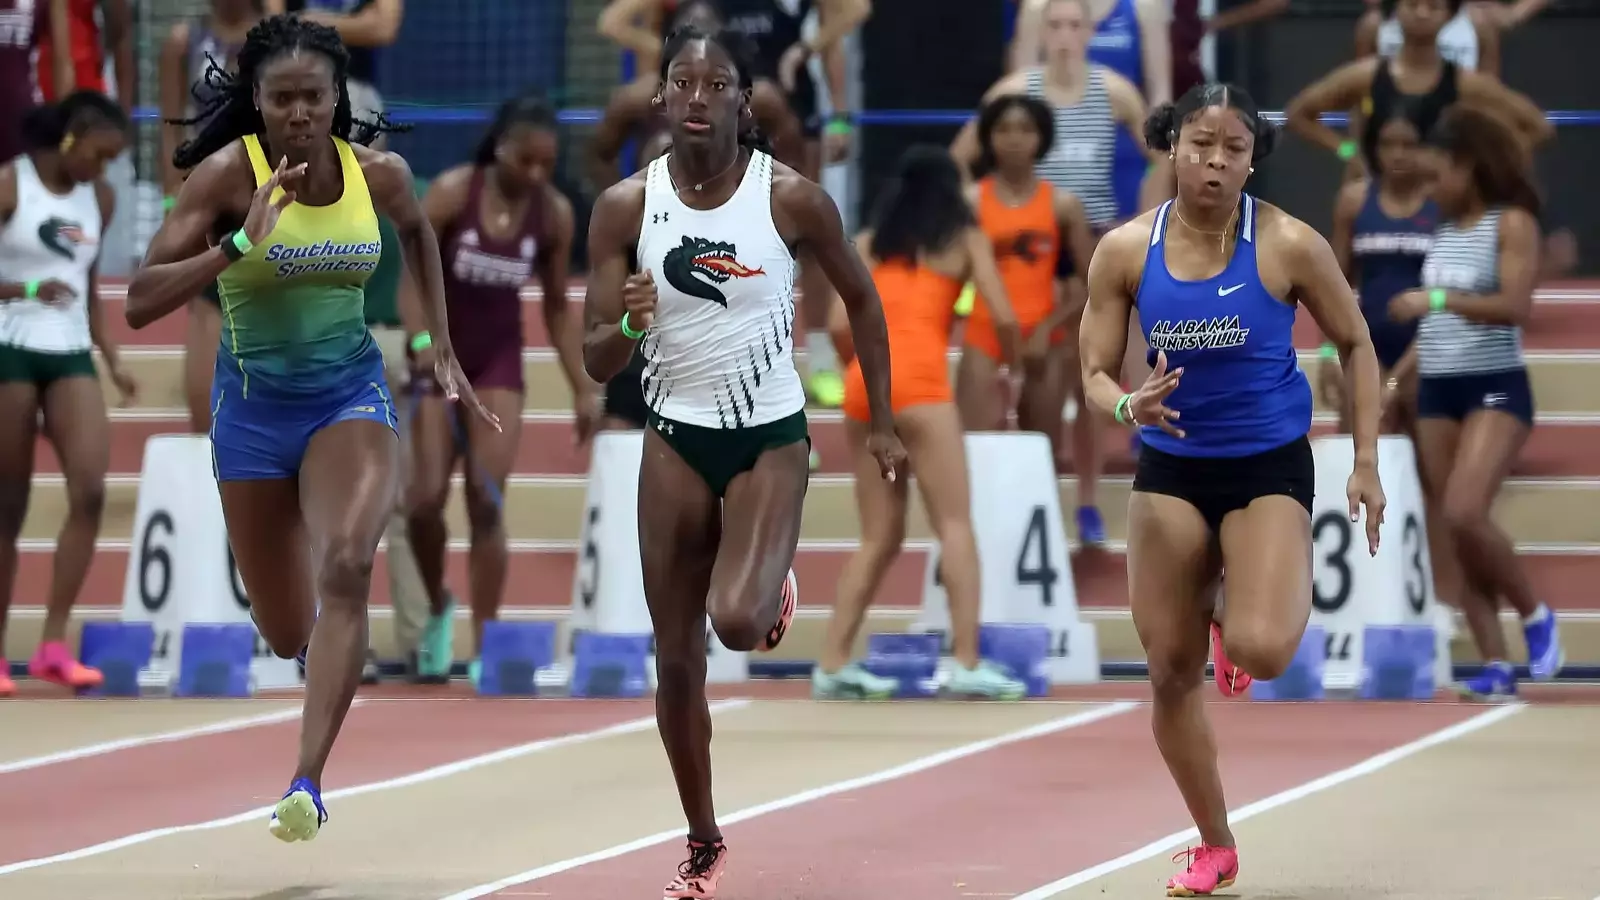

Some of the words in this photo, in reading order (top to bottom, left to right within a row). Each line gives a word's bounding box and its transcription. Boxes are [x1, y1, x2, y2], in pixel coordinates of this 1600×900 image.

[264, 238, 381, 261] Southwest
[275, 257, 376, 279] Sprinters
[1149, 329, 1250, 351] HUNTSVILLE
[1151, 315, 1240, 335] ALABAMA
[139, 509, 174, 613] 6
[580, 507, 600, 607] 5
[1016, 504, 1058, 607] 4
[1312, 509, 1352, 614] 3
[1402, 512, 1426, 615] 3
